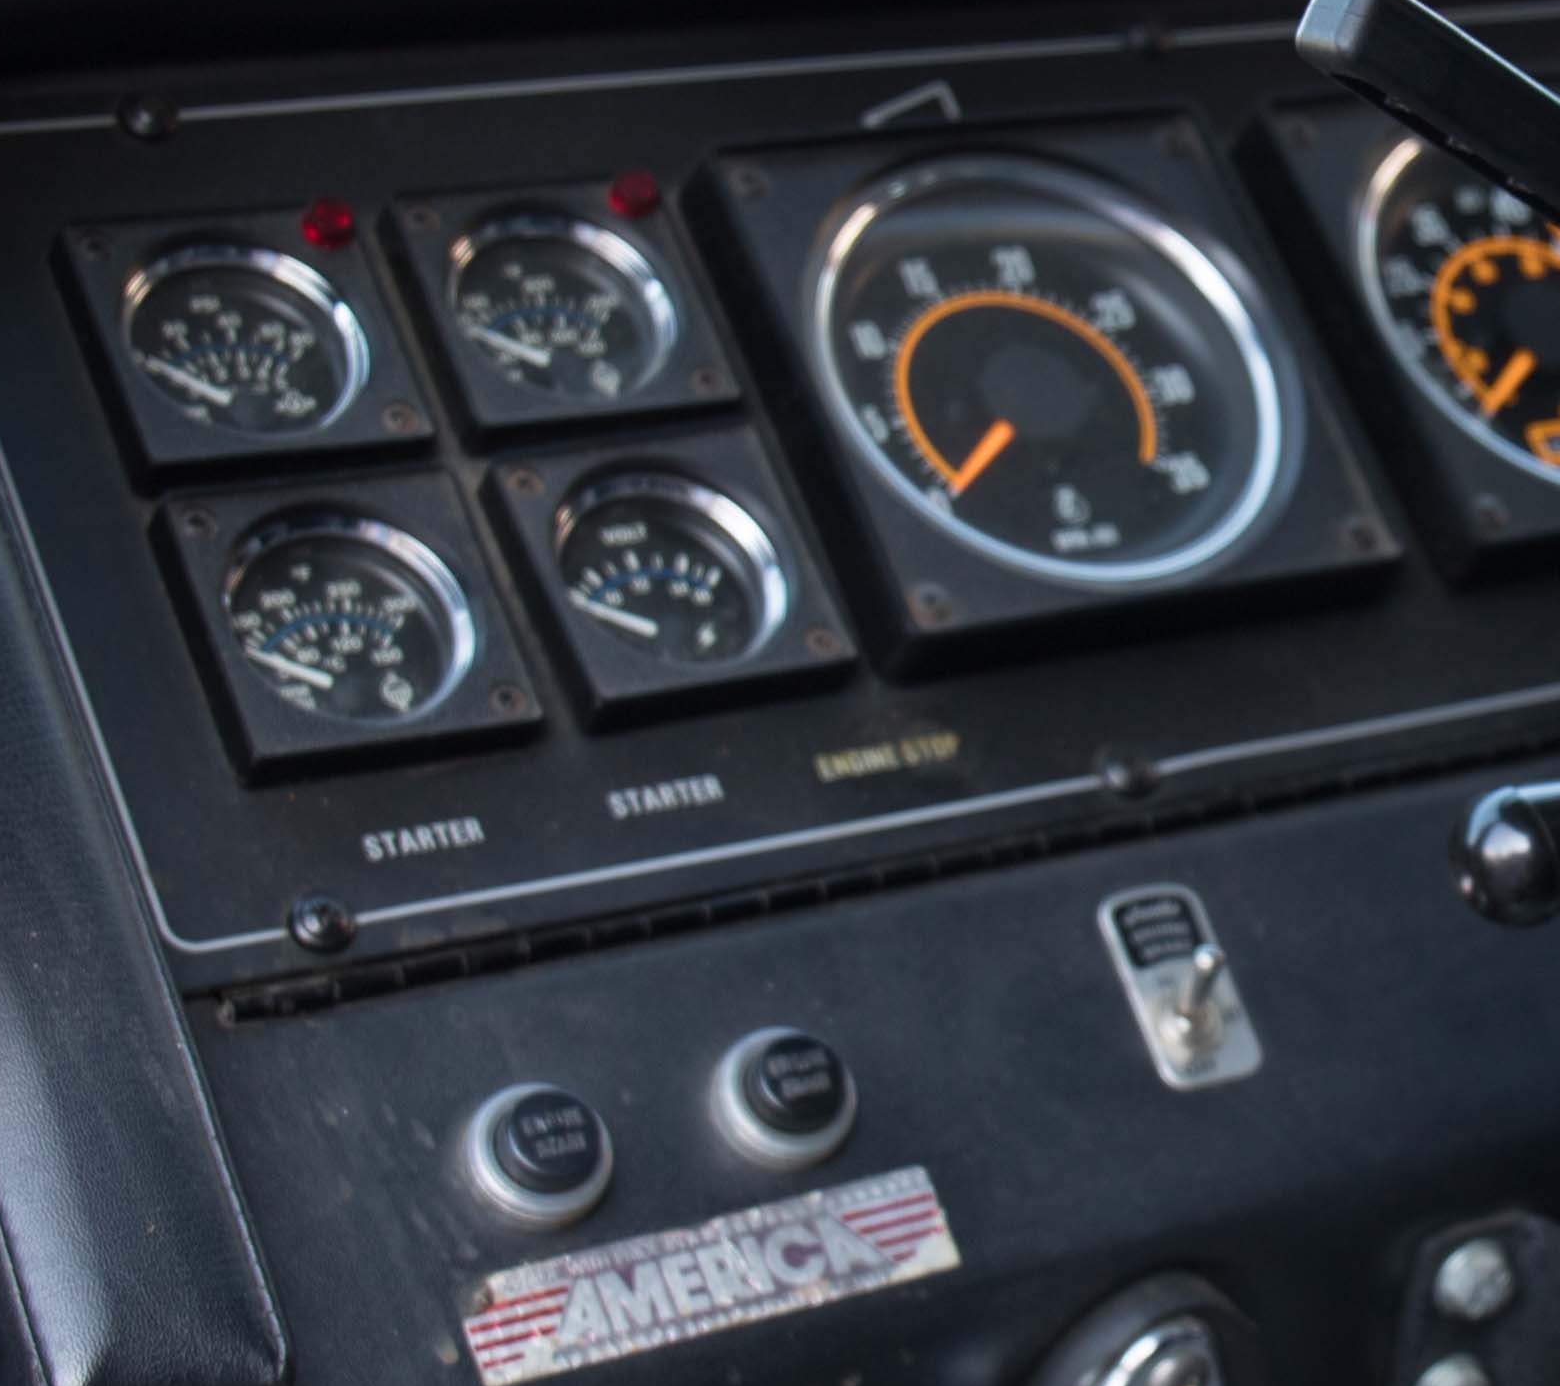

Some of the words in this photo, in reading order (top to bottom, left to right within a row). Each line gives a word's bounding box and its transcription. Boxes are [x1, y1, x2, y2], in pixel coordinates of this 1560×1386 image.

[898, 257, 939, 299] 15
[990, 245, 1037, 286] 20
[1090, 289, 1137, 331] 25
[813, 743, 900, 784] ENGINE
[899, 730, 961, 768] STOP
[606, 773, 726, 820] STARTER
[361, 816, 486, 862] STARTER
[554, 1213, 897, 1344] AMERICA
